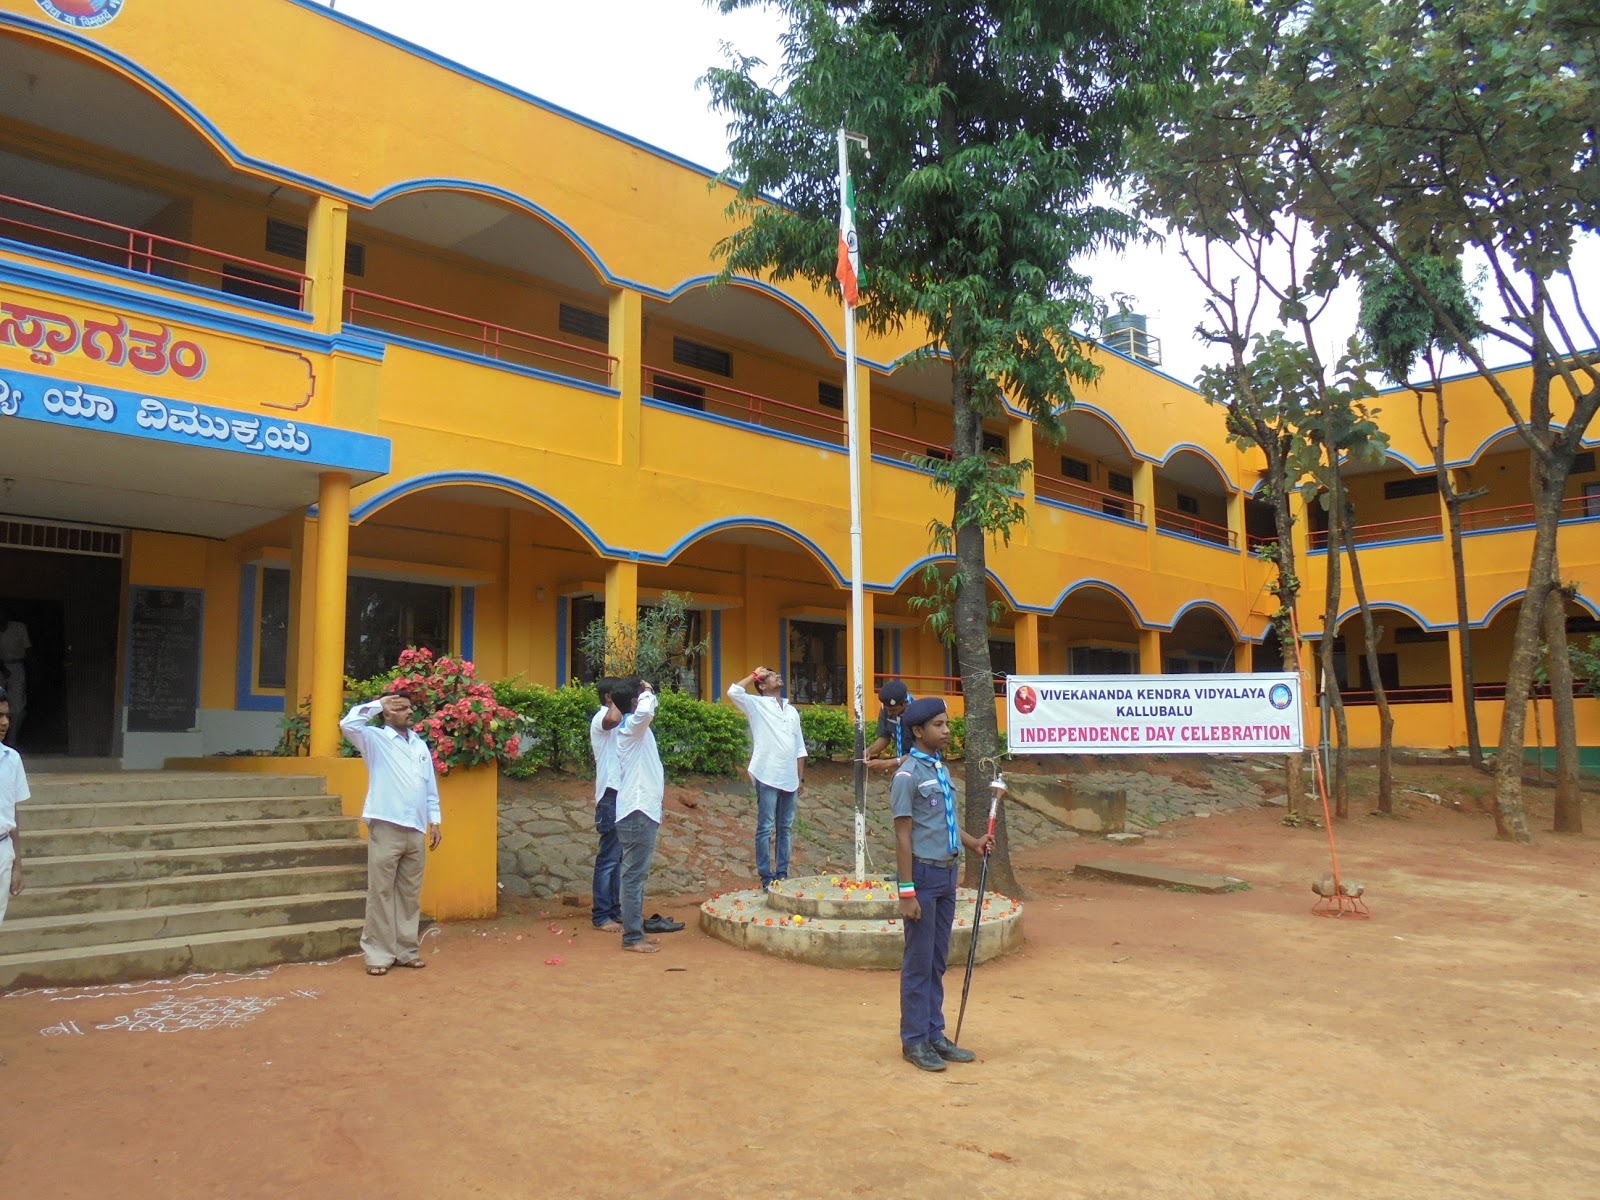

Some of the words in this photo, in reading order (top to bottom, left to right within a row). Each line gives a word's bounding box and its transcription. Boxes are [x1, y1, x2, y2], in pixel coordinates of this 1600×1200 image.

[43, 385, 115, 423] ಯಾ
[1040, 689, 1133, 701] VIVEKANANDA
[1137, 688, 1191, 700] KENDRA
[1194, 687, 1266, 699] VIDYALAYA
[1116, 705, 1193, 717] KALLUBALU
[1020, 726, 1140, 743] INDEPENDENCE
[1145, 726, 1176, 741] DAY
[1180, 725, 1291, 741] CELEBRATION
